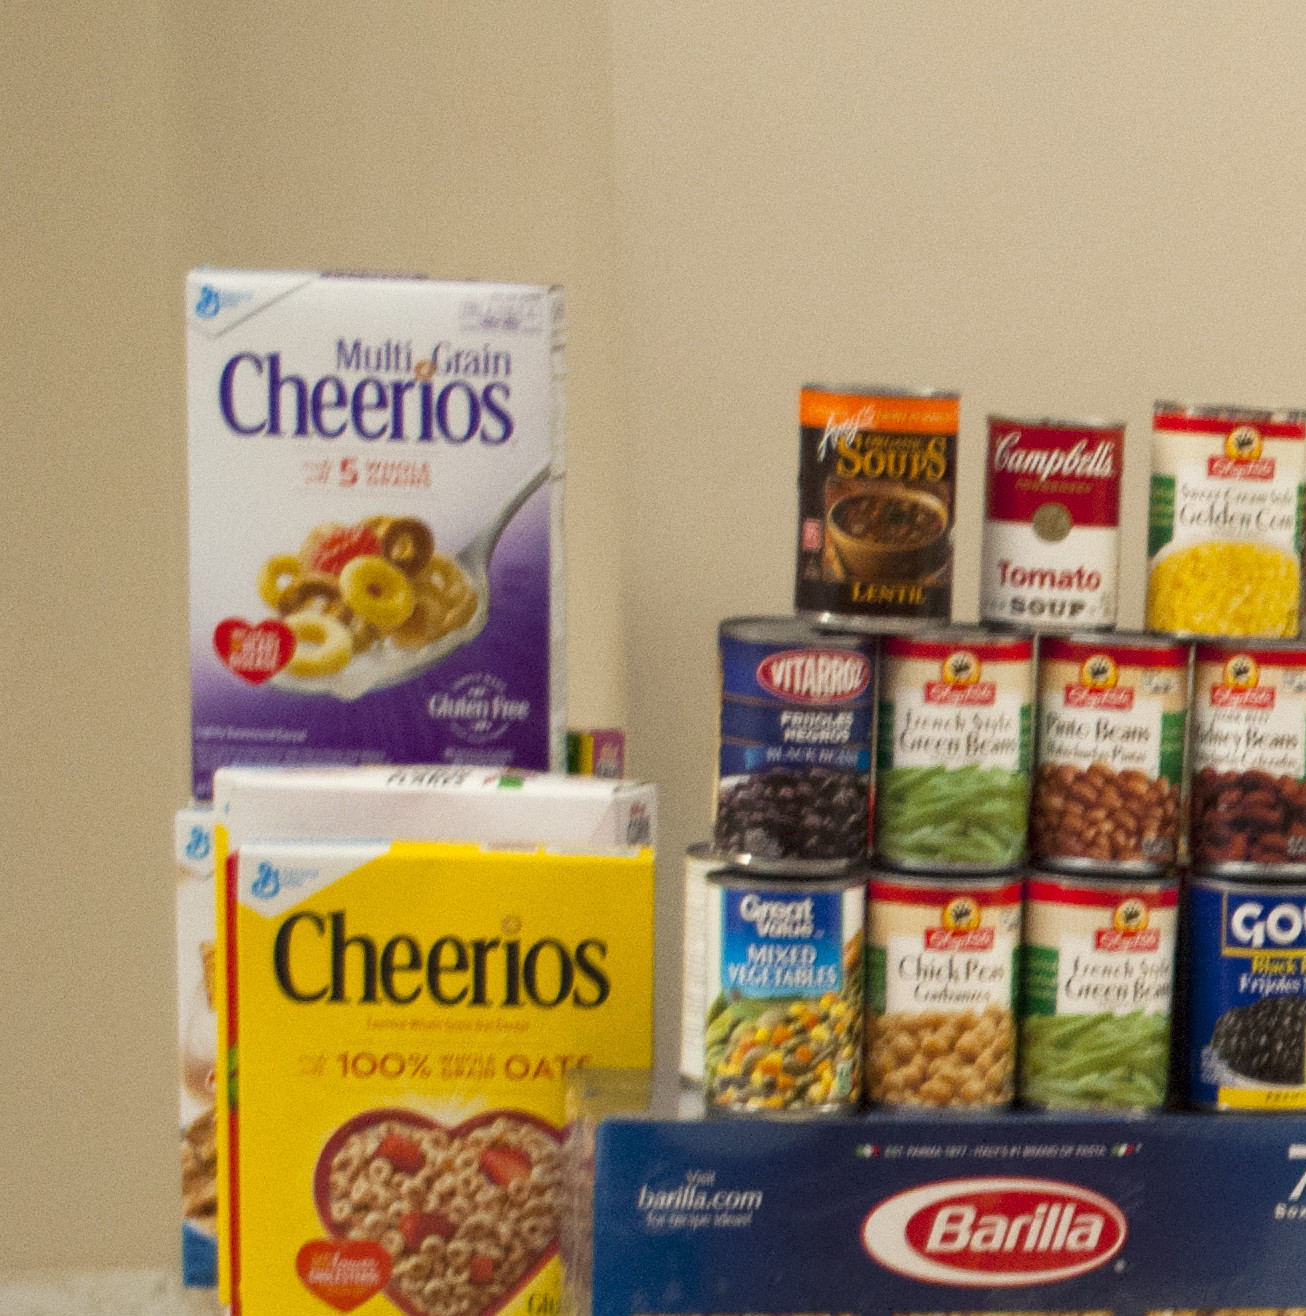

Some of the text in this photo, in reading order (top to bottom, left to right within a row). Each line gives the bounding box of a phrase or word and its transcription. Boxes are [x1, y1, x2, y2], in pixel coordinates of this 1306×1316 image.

[336, 338, 512, 377] Multi Grain
[218, 350, 515, 446] Cheerios
[994, 437, 1115, 481] Campbell's
[998, 560, 1102, 592] Tomato
[1008, 596, 1086, 618] SOUP
[1095, 716, 1151, 744] Beans
[740, 893, 816, 925] Great
[272, 908, 612, 1010] Cheerios
[746, 942, 818, 968] MIXED
[727, 962, 838, 989] VEGETABLES
[336, 1051, 432, 1080] 100%
[637, 1184, 764, 1211] barilla.com
[925, 1202, 1107, 1254] Barilla
